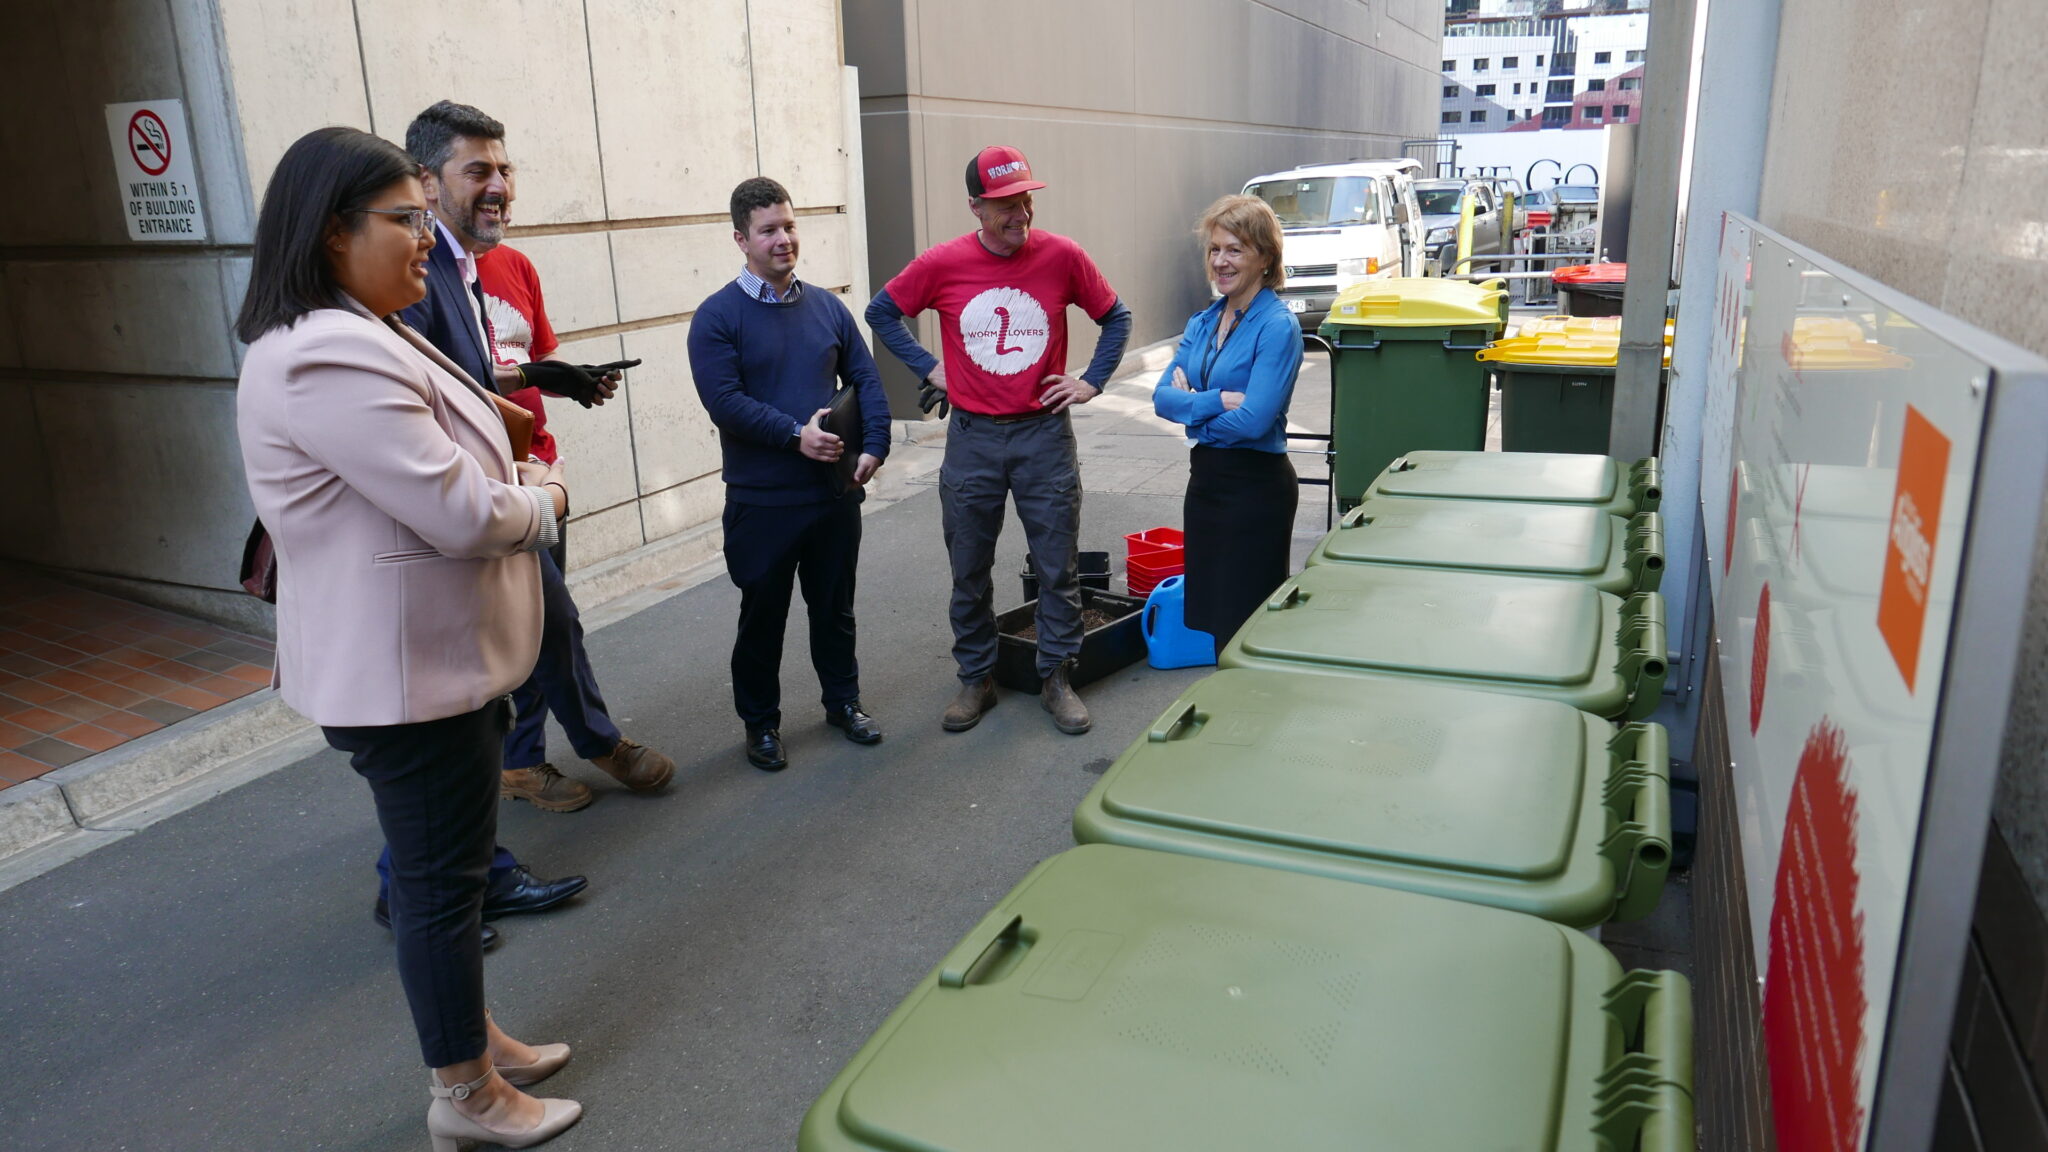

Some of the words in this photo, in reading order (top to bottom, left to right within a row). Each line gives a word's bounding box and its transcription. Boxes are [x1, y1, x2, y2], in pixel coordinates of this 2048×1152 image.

[130, 182, 168, 197] WITHIN
[170, 182, 178, 196] 5
[129, 201, 142, 215] OF
[146, 199, 195, 215] BUILDING
[139, 218, 193, 233] ENTRANCE
[1008, 329, 1044, 337] LOVERS
[496, 341, 526, 349] LOVERS
